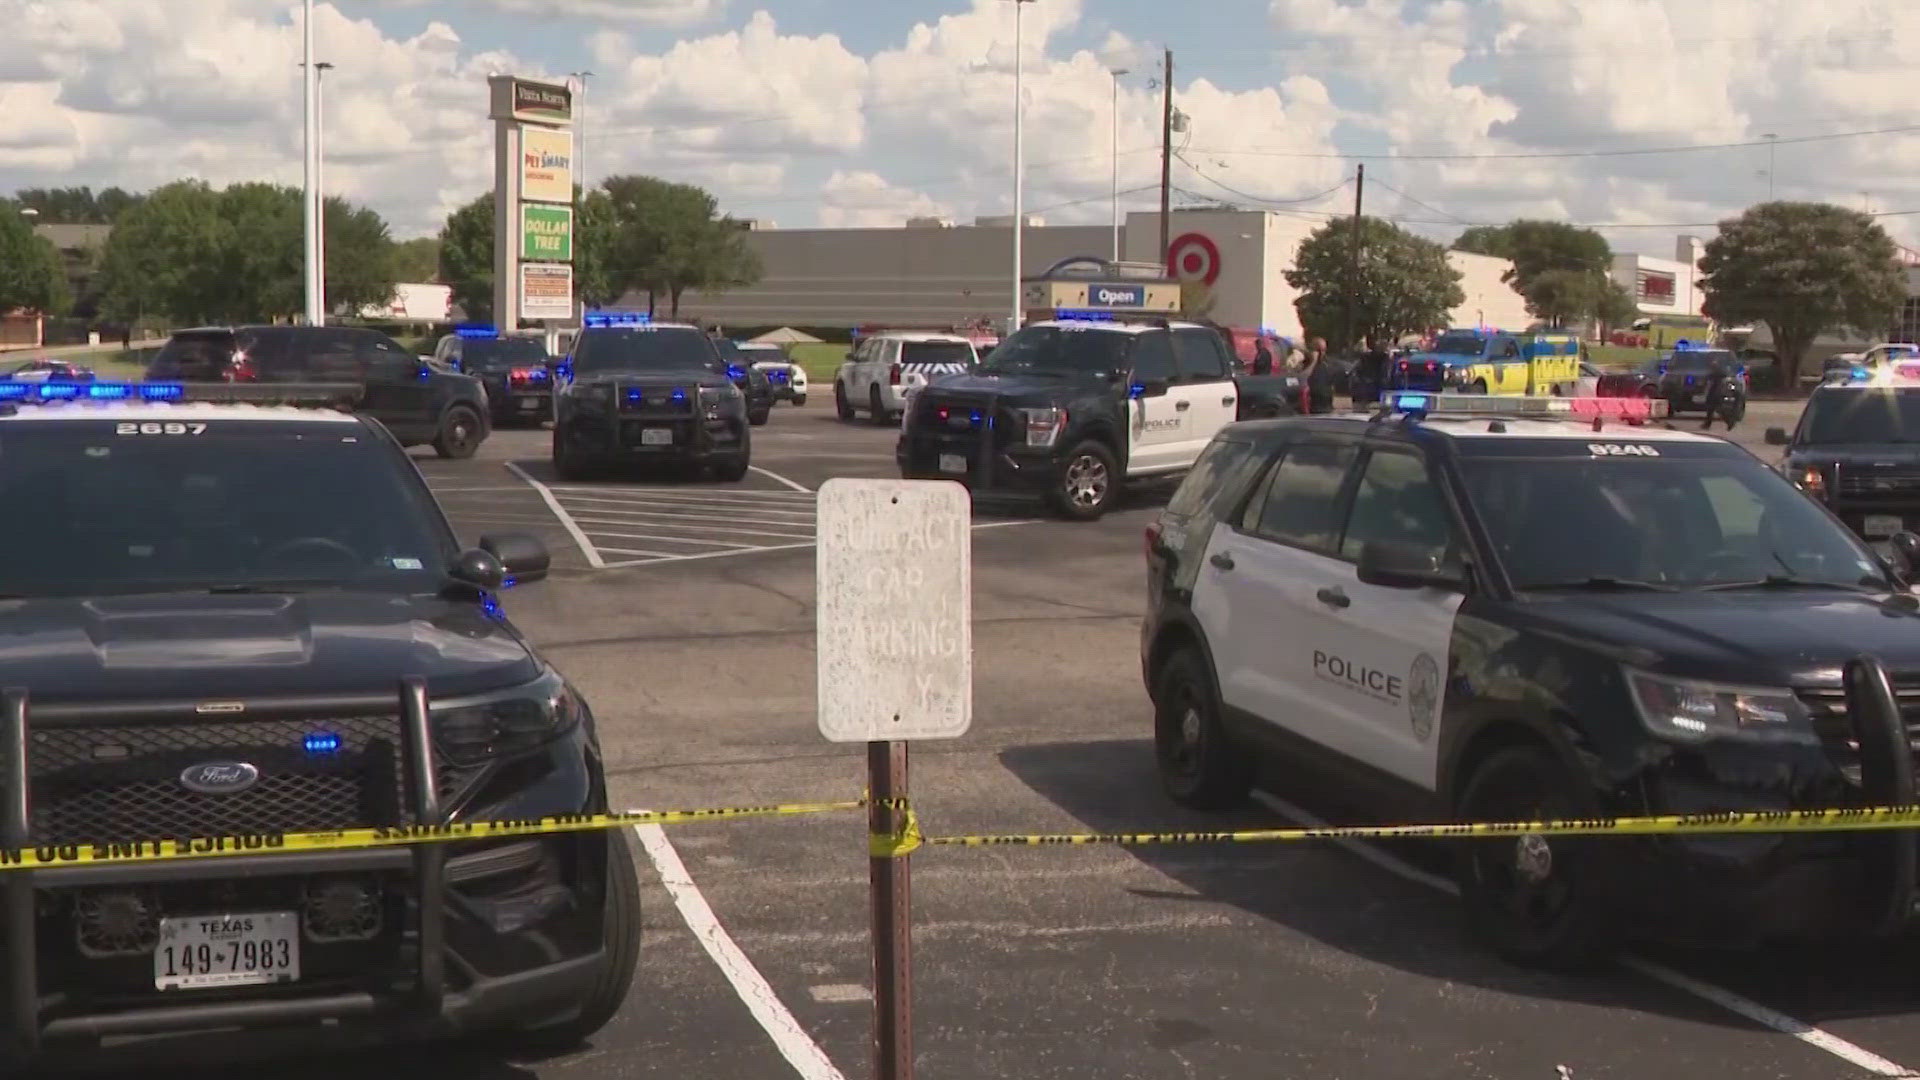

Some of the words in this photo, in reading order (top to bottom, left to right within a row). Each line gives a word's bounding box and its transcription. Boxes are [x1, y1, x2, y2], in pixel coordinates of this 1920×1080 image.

[525, 219, 568, 236] DOLLAR
[534, 235, 561, 250] TREE
[1098, 288, 1135, 306] Open
[116, 422, 207, 435] 2697
[837, 618, 957, 657] ARKING
[1313, 649, 1403, 699] POLICE
[200, 765, 241, 783] Ford
[201, 919, 254, 934] TEXAS
